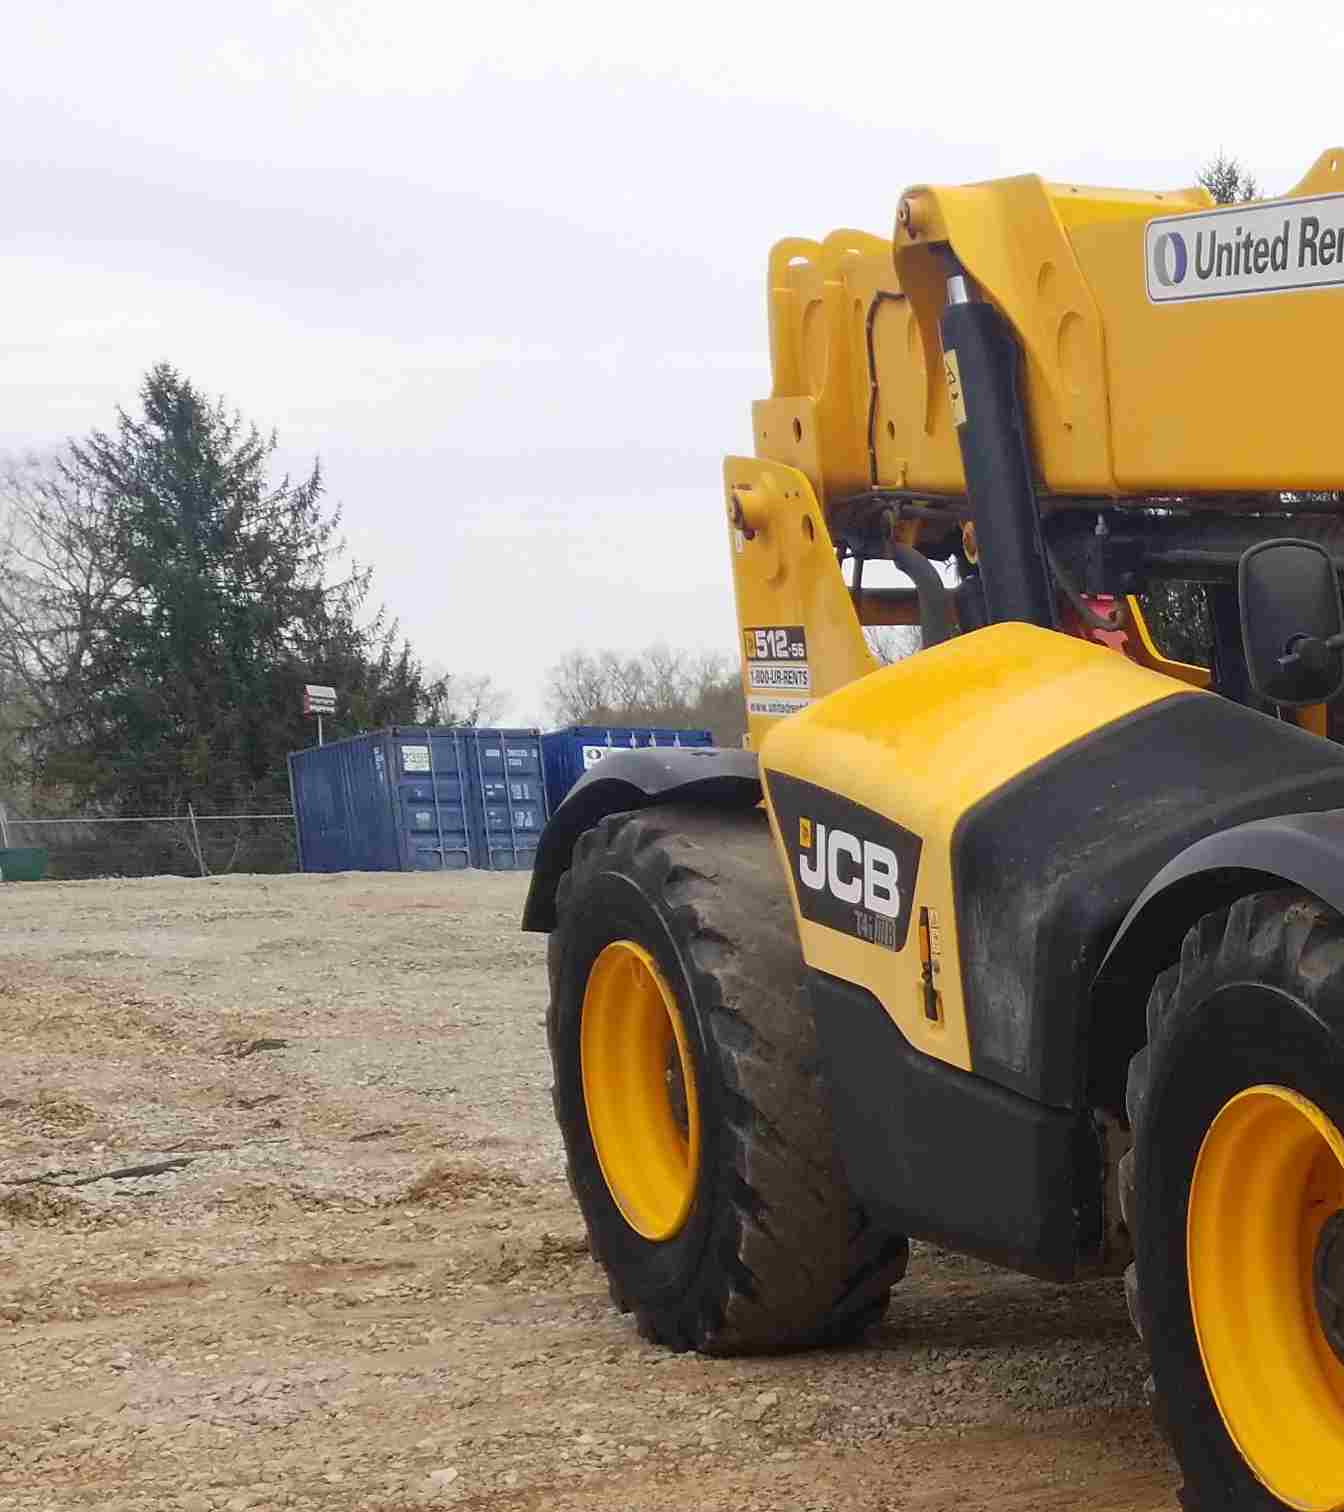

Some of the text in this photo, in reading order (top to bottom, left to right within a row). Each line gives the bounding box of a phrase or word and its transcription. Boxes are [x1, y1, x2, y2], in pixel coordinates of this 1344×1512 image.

[1195, 219, 1290, 281] United
[755, 629, 805, 658] 512-56
[799, 823, 900, 918] JCB
